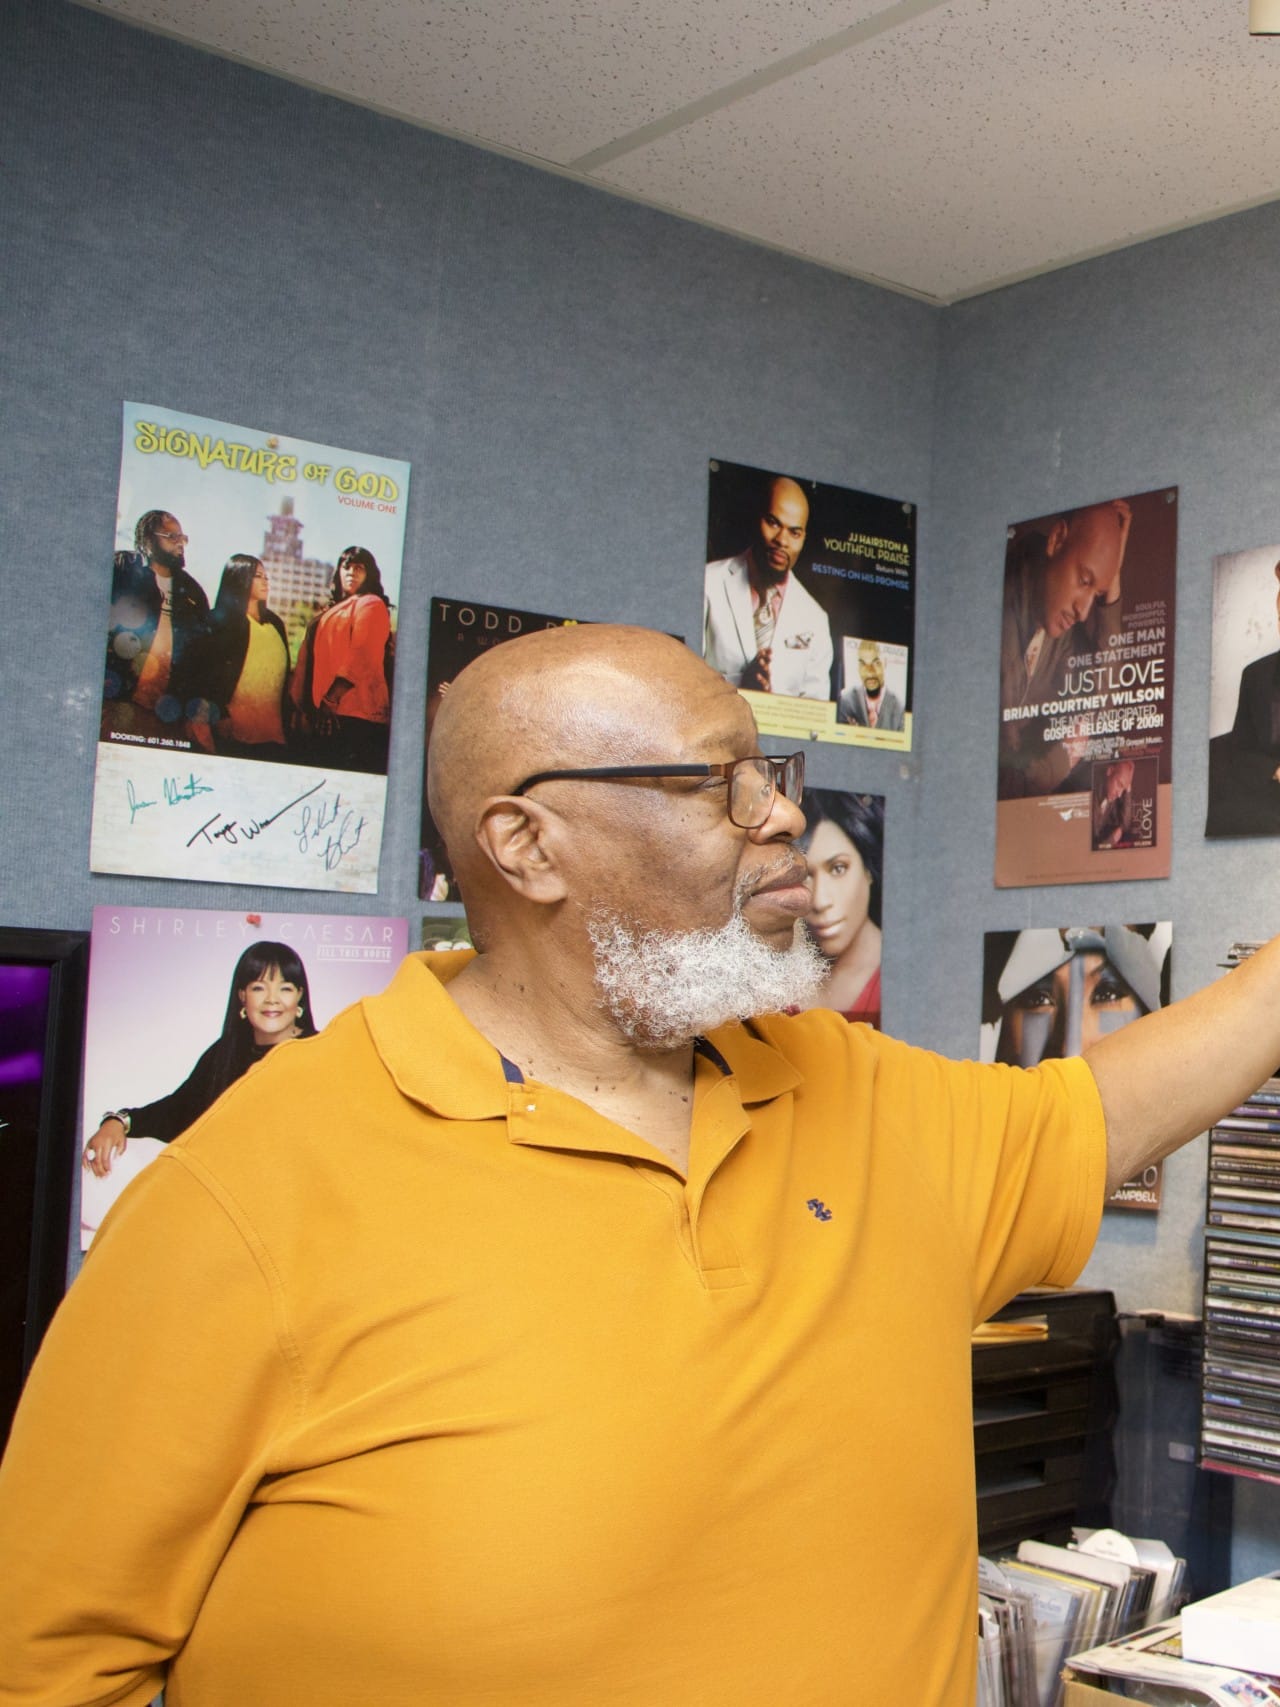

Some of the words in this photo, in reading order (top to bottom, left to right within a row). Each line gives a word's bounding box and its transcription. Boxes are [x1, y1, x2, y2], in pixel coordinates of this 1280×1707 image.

[304, 463, 331, 485] OF
[335, 467, 399, 501] GOD
[338, 496, 374, 511] VOLUME
[378, 503, 397, 515] ONE
[824, 537, 876, 559] YOUTHFUL
[877, 549, 910, 566] PRAISE
[847, 570, 860, 580] ON
[439, 603, 522, 634] TODD
[1108, 631, 1135, 647] ONE
[1136, 626, 1166, 642] MAN
[1068, 653, 1093, 669] ONE
[1095, 643, 1166, 665] STATEMENT
[1057, 668, 1107, 697] JUST
[1108, 659, 1165, 689] LOVE
[1003, 704, 1039, 722] BRIAN
[1041, 694, 1108, 716] COURTNEY
[1111, 686, 1165, 706] WILSON
[1097, 704, 1157, 721] ANTICIPATED
[1043, 725, 1077, 742] GOSPEL
[1079, 719, 1120, 738] RELEASE
[1121, 718, 1134, 732] OF
[1136, 714, 1164, 730] 2009!
[110, 915, 251, 938] SHIRLEY
[280, 922, 394, 943] CAESAR
[1110, 1189, 1158, 1204] AMPBELL
